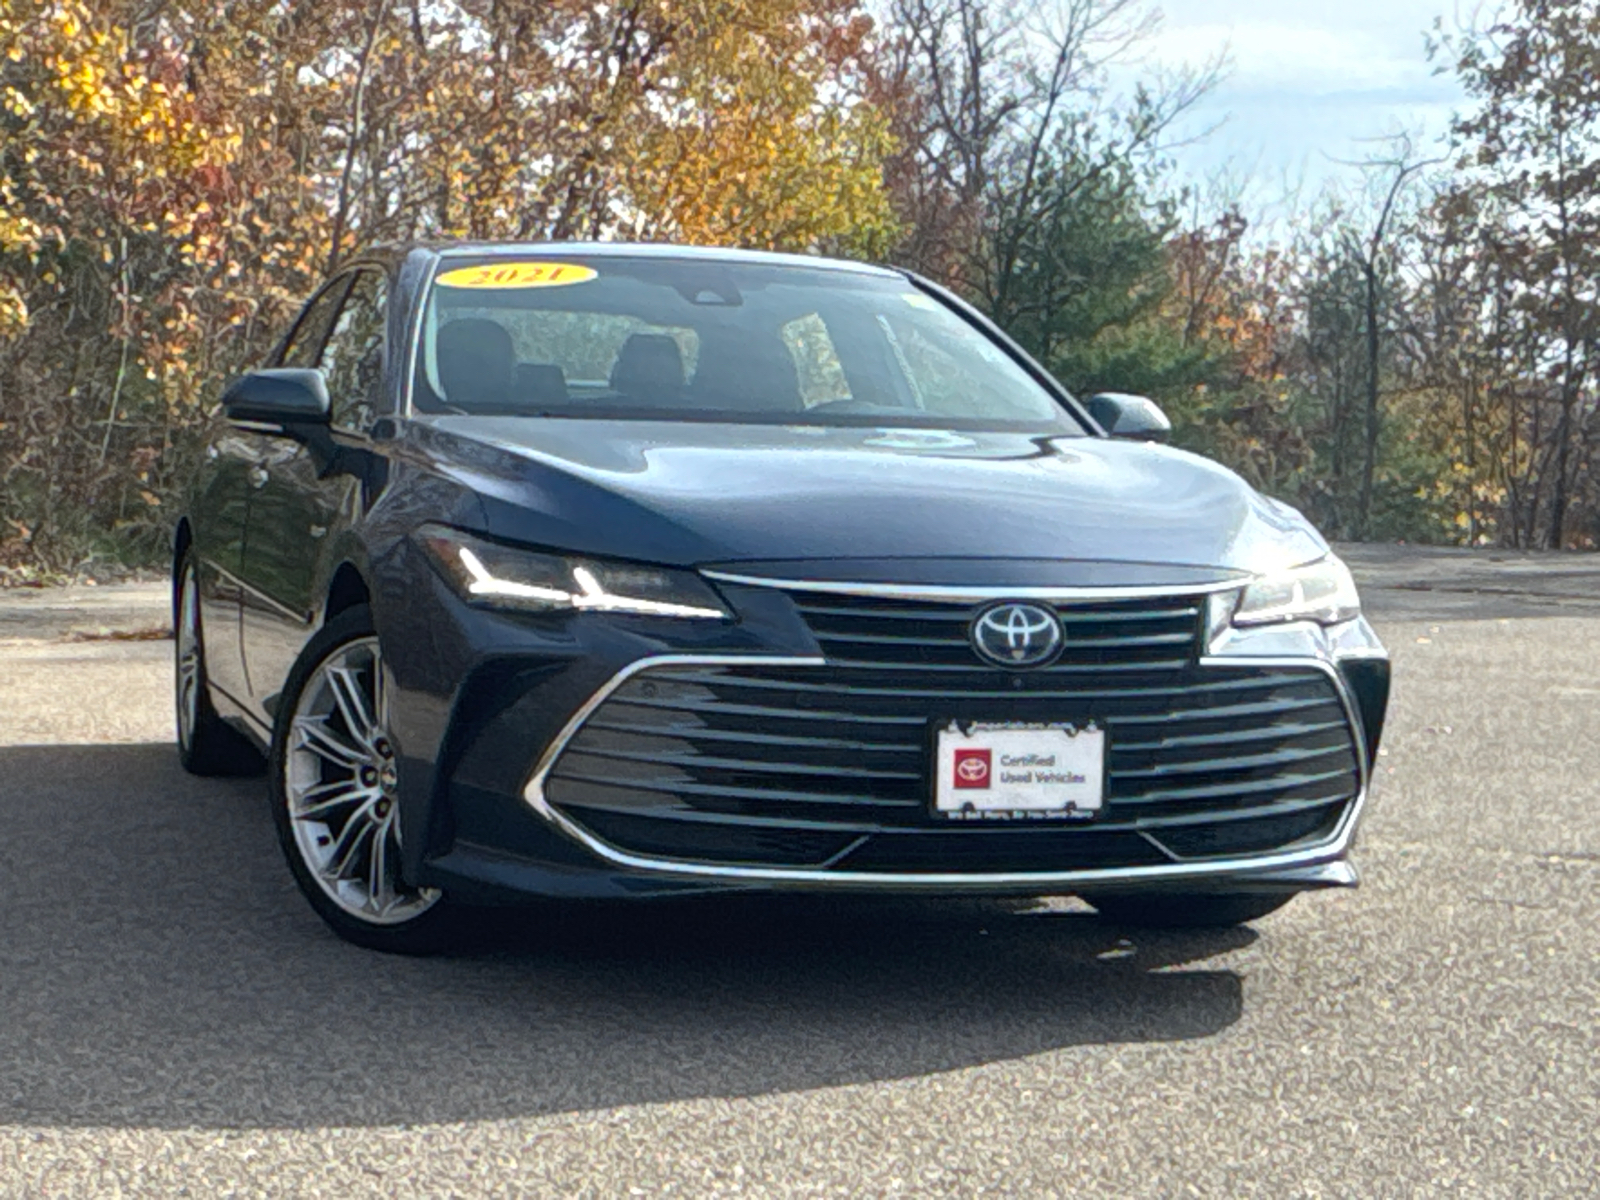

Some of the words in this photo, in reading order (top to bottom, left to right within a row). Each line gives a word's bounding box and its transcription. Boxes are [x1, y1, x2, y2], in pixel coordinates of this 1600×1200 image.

[468, 268, 564, 284] 2021
[1000, 755, 1055, 766] Certified
[1000, 772, 1032, 783] Used
[1035, 771, 1086, 783] Vehicles
